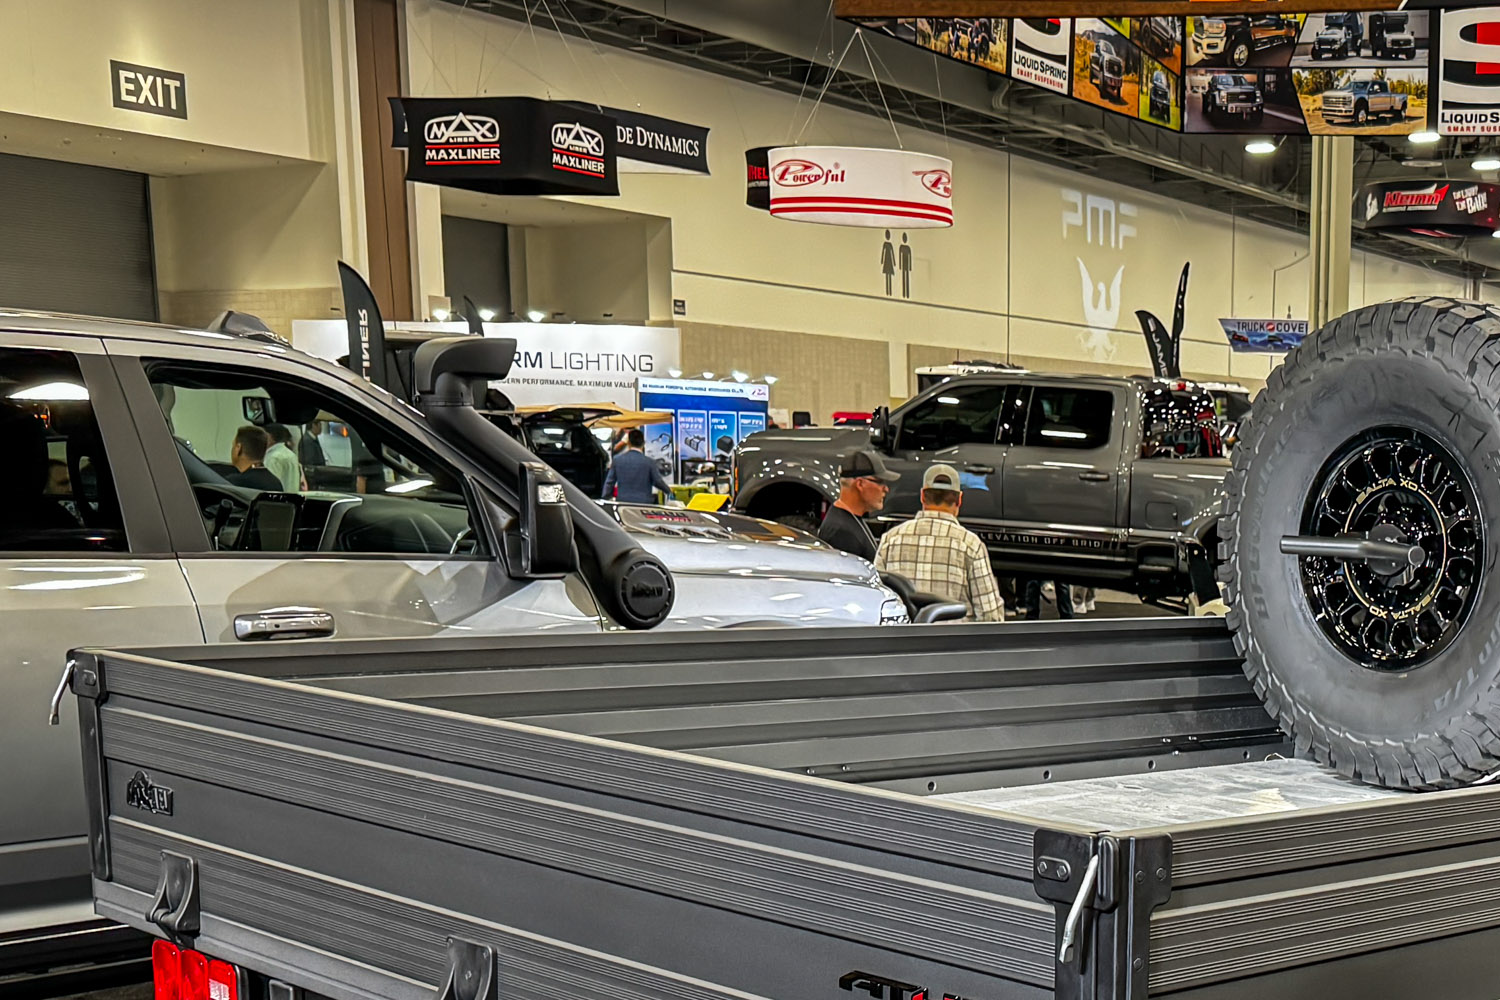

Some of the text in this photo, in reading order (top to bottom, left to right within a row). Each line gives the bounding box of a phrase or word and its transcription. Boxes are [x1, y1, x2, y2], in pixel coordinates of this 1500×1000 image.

[119, 69, 181, 110] EXIT
[636, 127, 699, 157] DYNAMICS
[425, 147, 501, 161] MAXLINER
[552, 153, 605, 174] MAXLINER
[1061, 188, 1138, 250] PMF
[1236, 322, 1265, 332] TRUCK
[550, 351, 654, 373] LIGHTING
[577, 380, 613, 388] MAXIMUM
